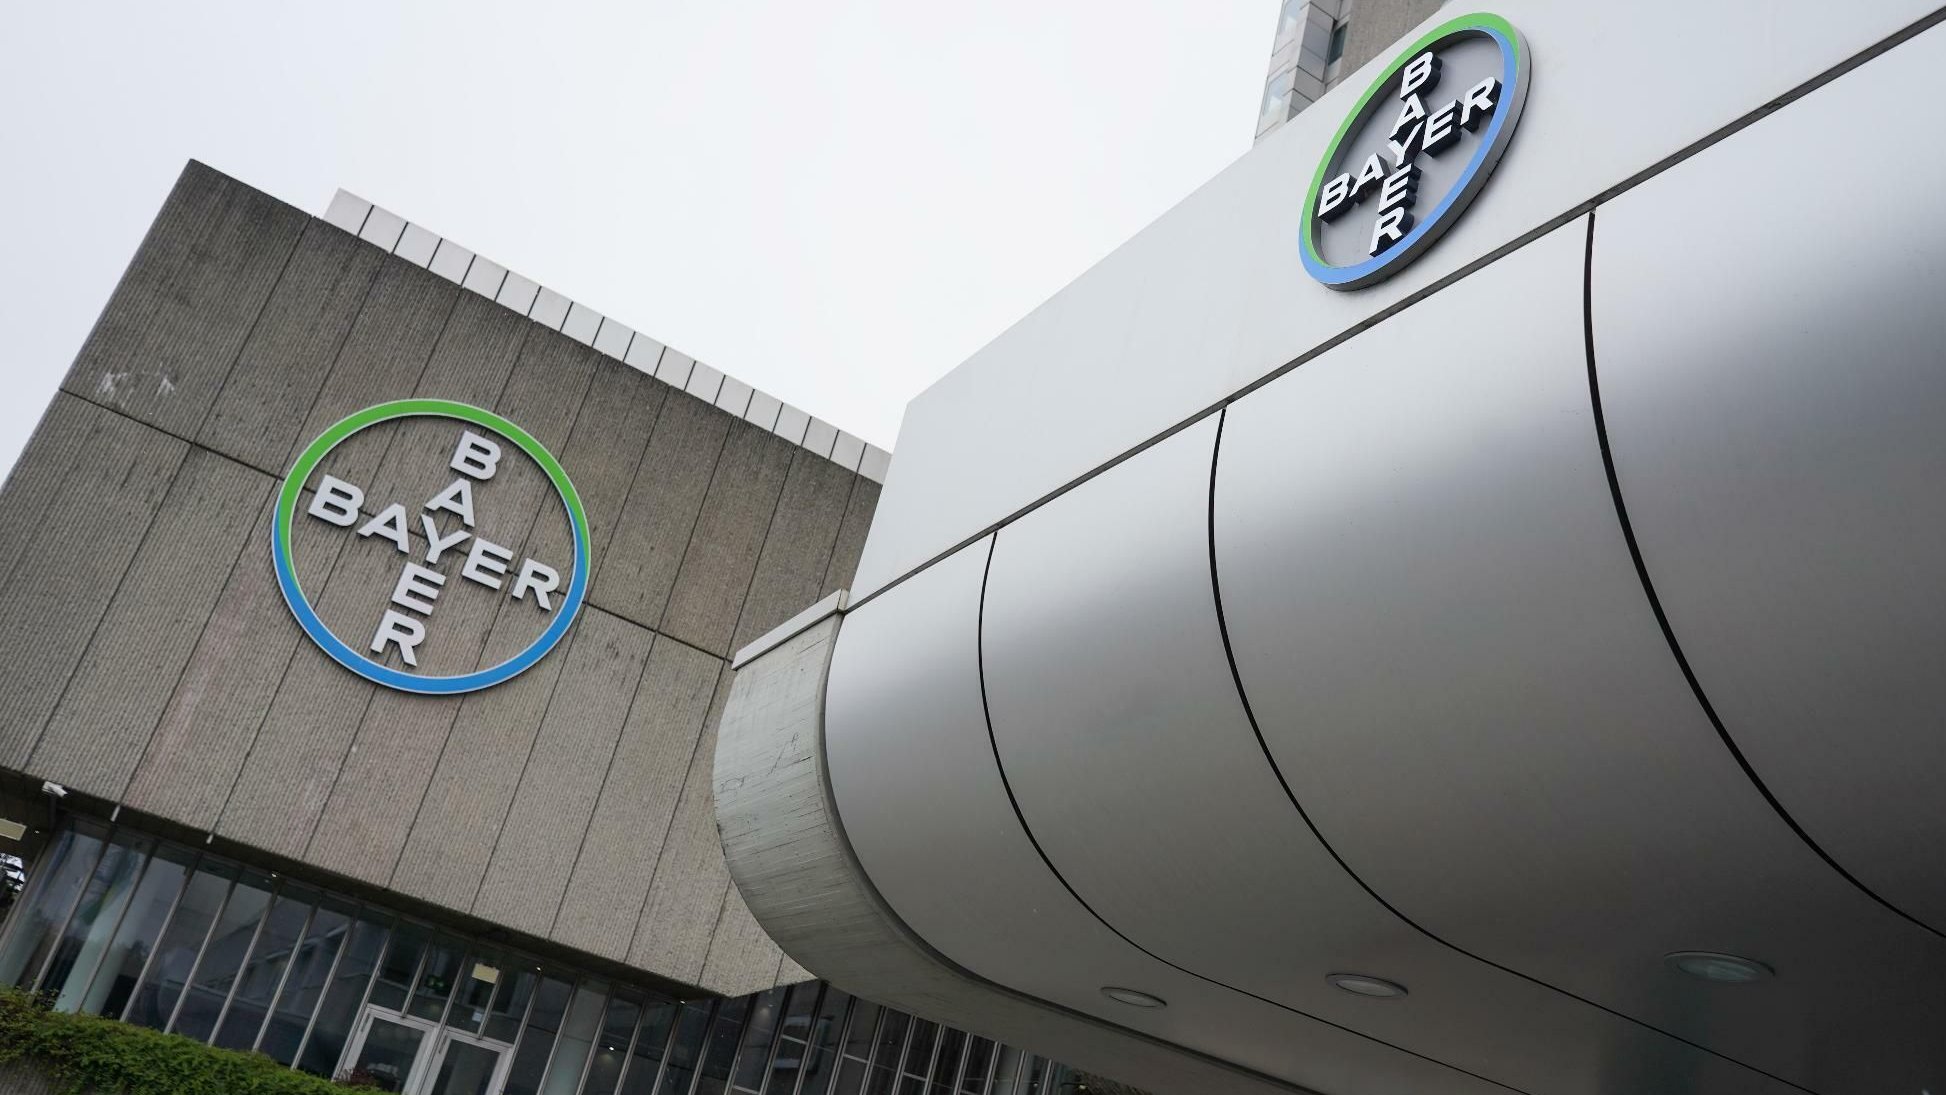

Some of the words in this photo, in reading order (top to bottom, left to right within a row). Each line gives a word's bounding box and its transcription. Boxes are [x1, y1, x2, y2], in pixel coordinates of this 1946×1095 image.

[1317, 75, 1496, 218] BAYER
[1368, 51, 1434, 256] BAYER
[307, 473, 562, 612] BAYER
[370, 429, 502, 668] BAYER
